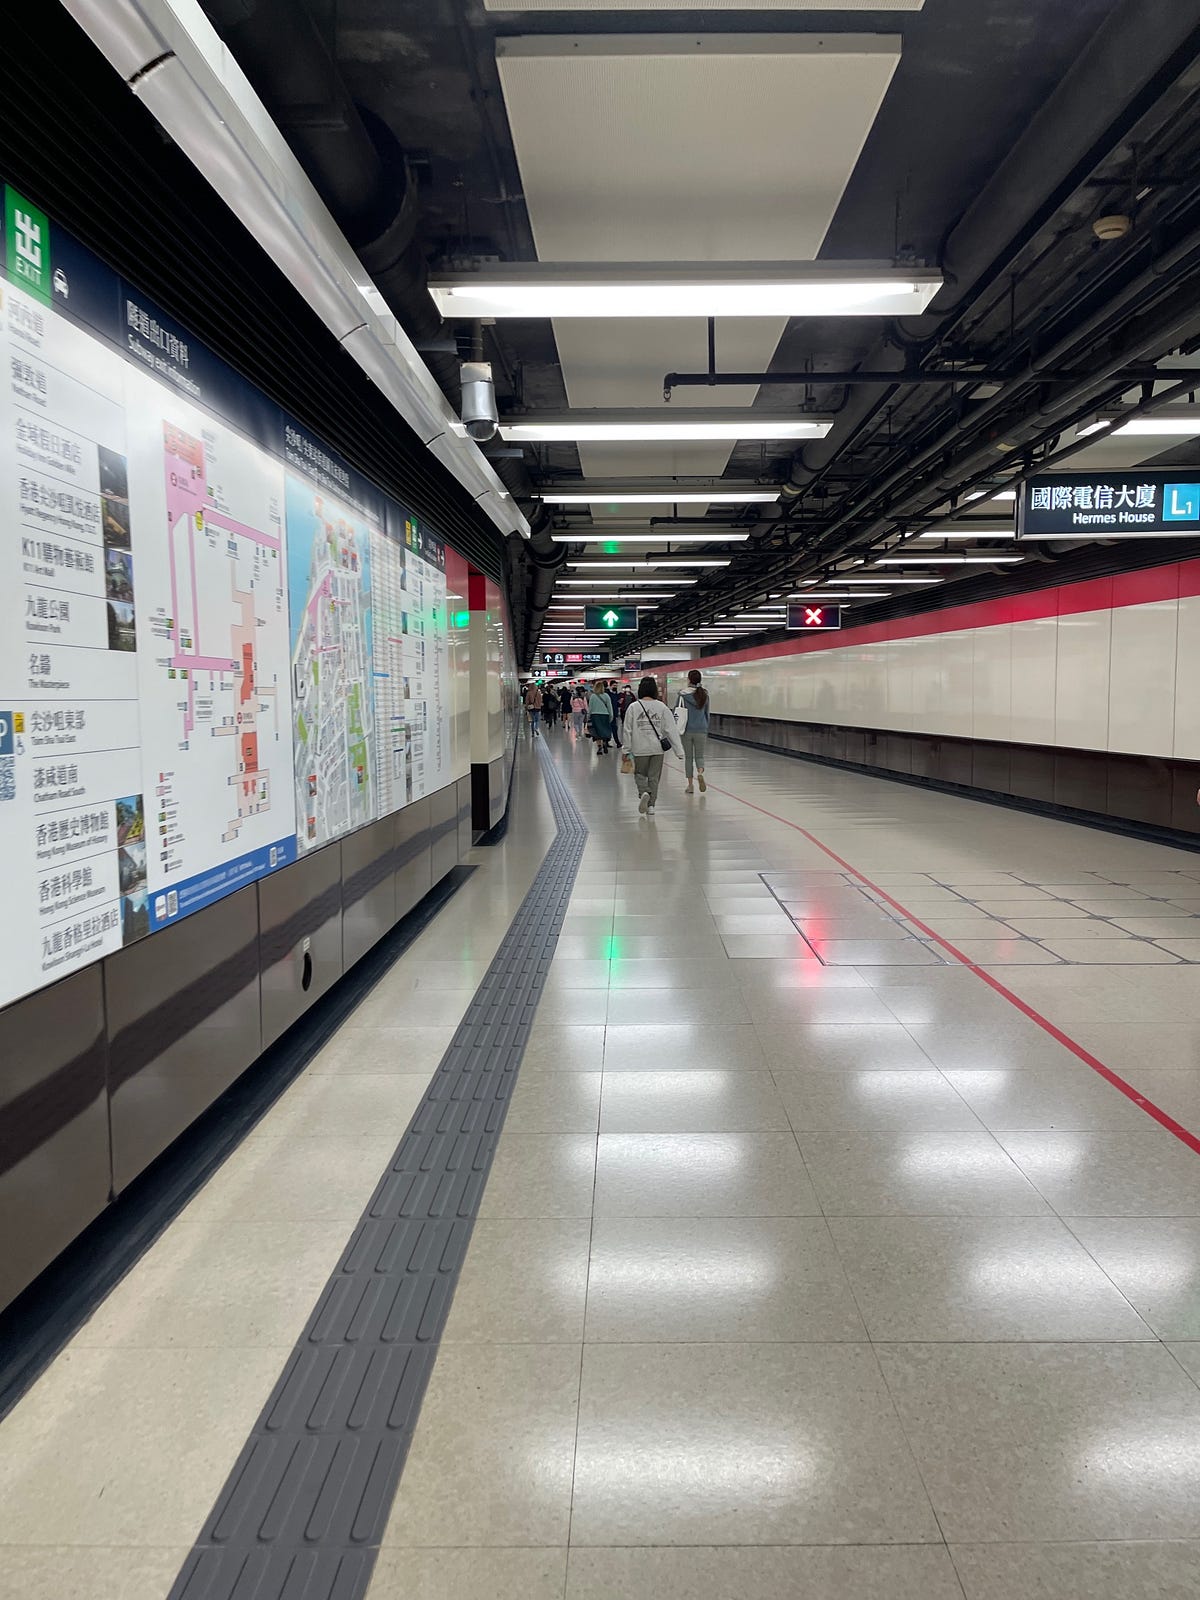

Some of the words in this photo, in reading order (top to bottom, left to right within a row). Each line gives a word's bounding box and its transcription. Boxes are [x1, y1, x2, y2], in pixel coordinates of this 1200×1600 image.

[15, 209, 41, 269] 出
[16, 255, 41, 286] EXIT
[1031, 484, 1157, 511] 國際電信大廈
[1073, 512, 1116, 525] Hermes
[1119, 511, 1155, 523] House
[39, 866, 92, 904] 香港科學館
